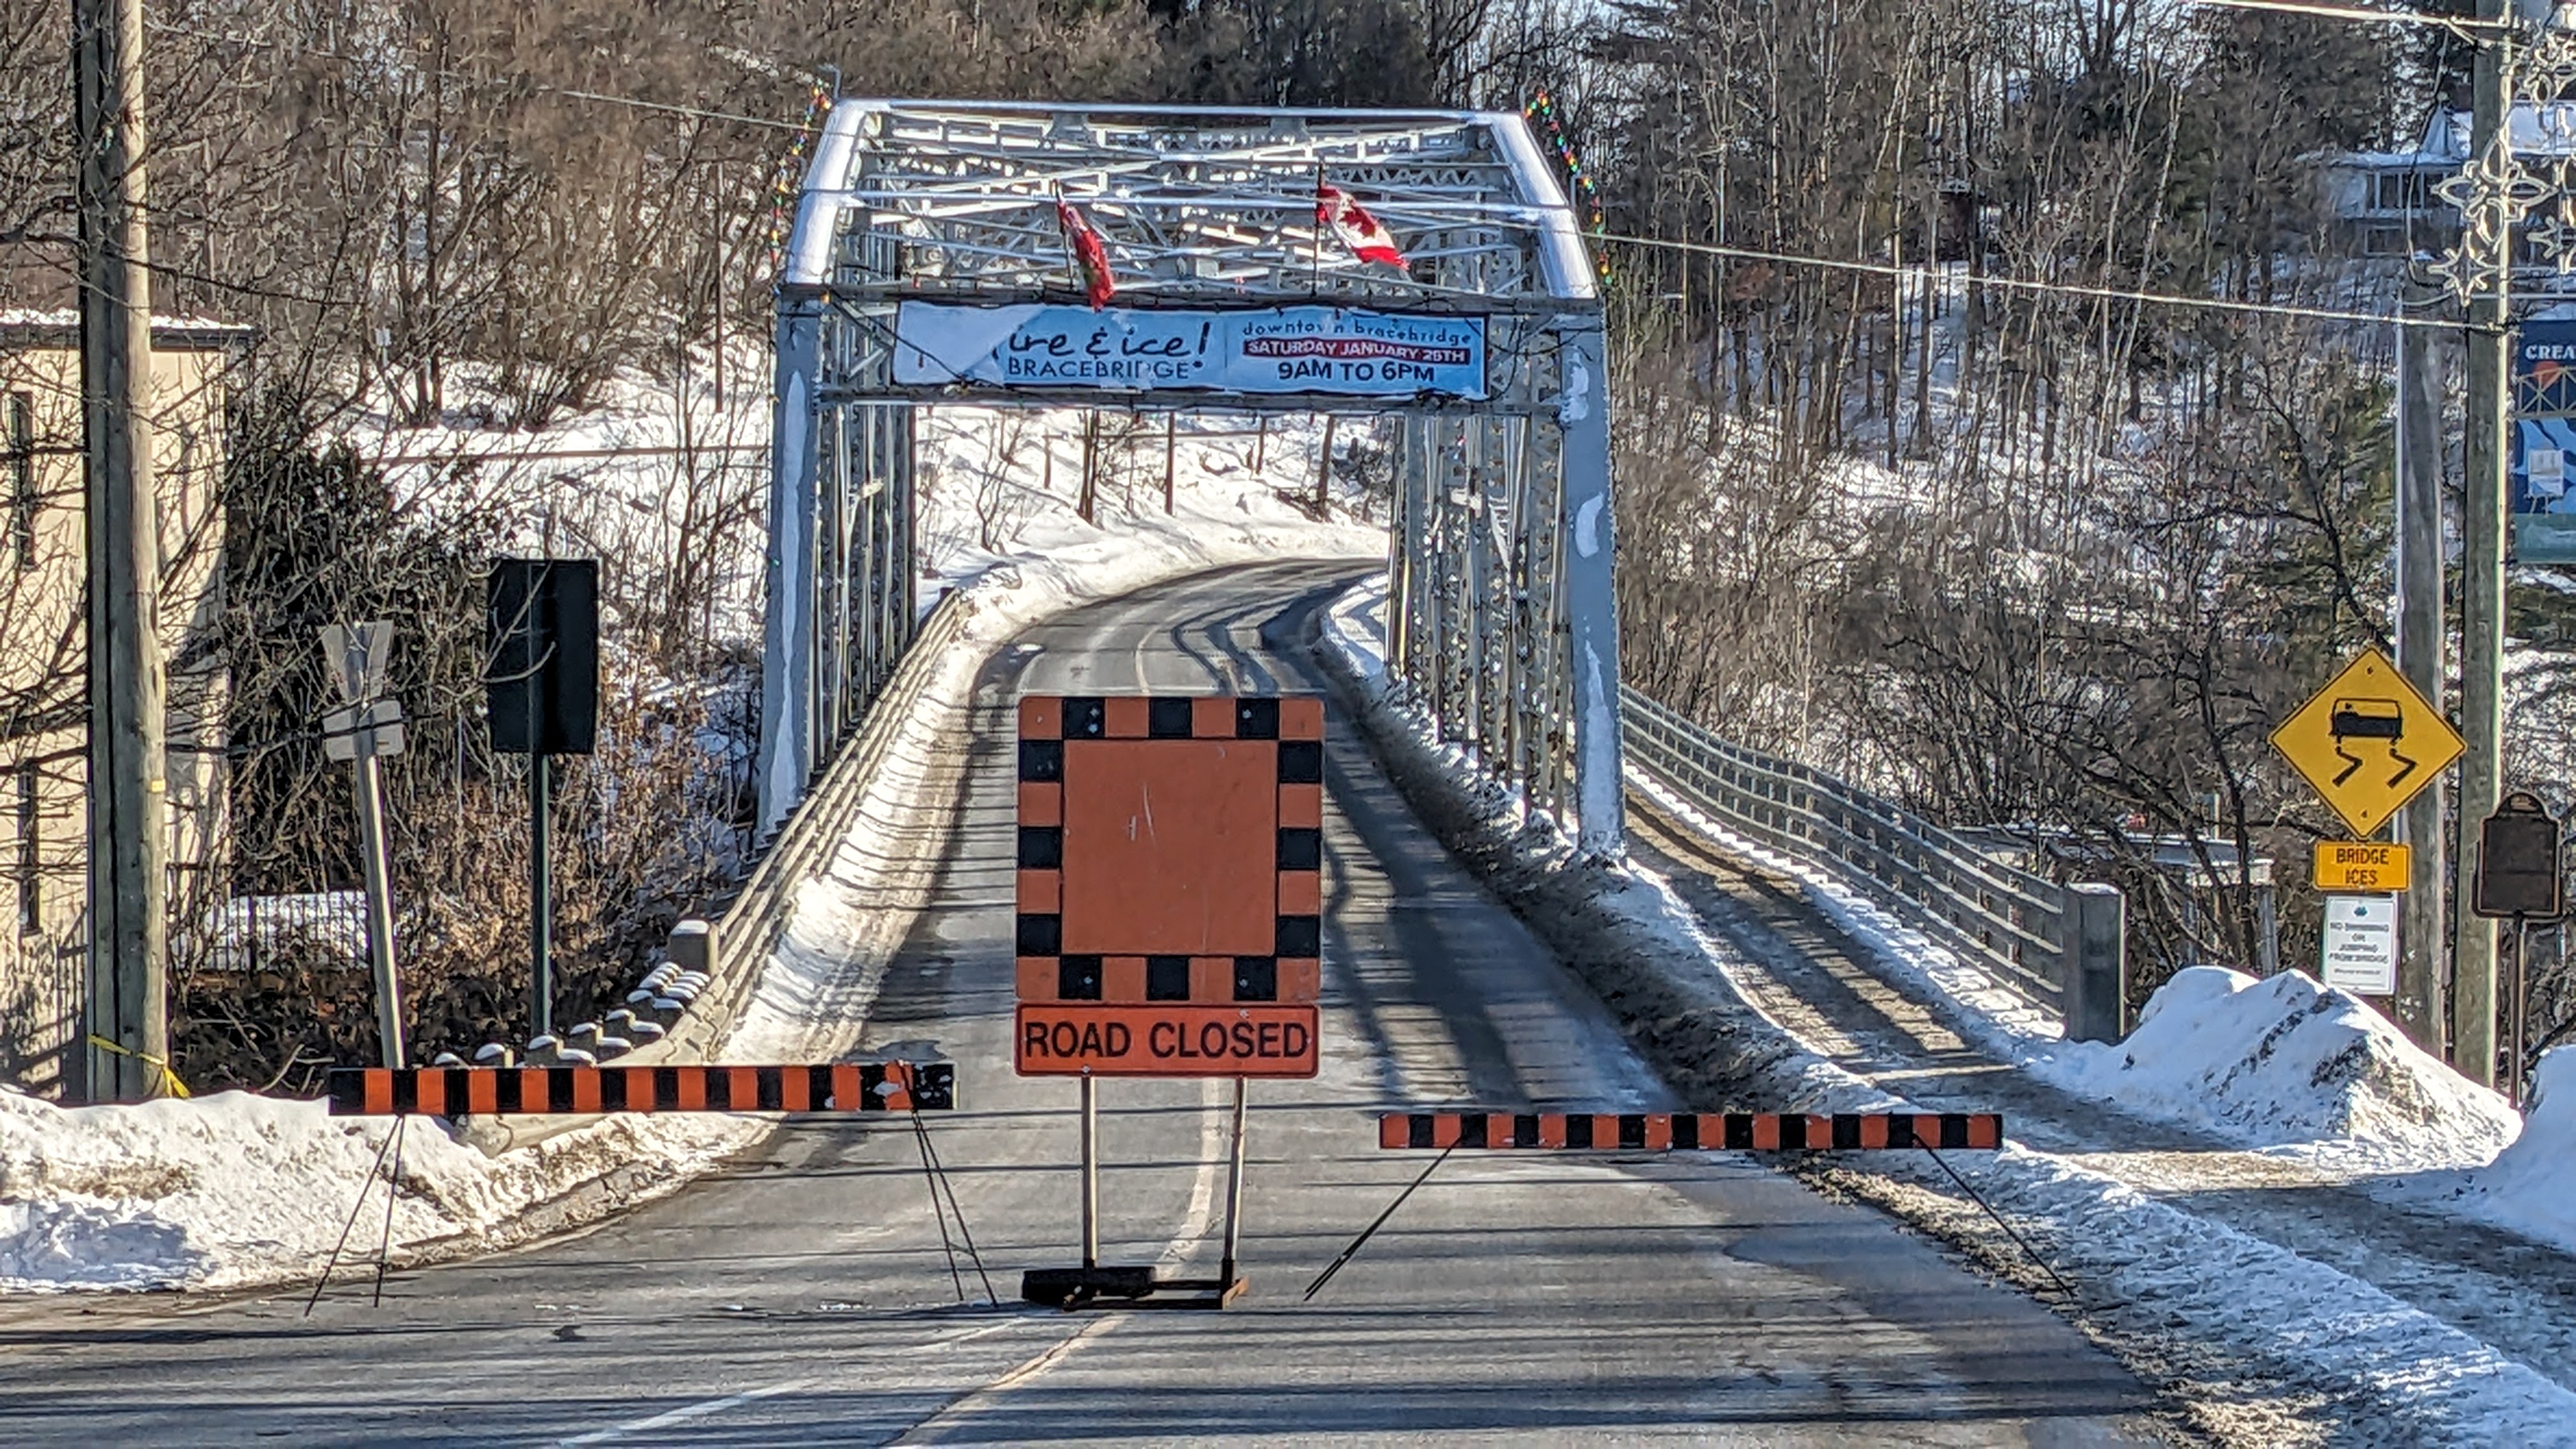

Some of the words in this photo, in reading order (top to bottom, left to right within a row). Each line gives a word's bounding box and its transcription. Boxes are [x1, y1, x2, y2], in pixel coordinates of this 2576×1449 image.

[992, 323, 1075, 360] ire
[1121, 321, 1211, 356] ice!
[1354, 319, 1471, 346] bracebridge
[1248, 340, 1337, 355] SATURDAY
[1340, 341, 1420, 360] JANUARY
[2525, 344, 2576, 360] CREA
[1278, 360, 1332, 380] 9AM
[1339, 362, 1373, 381] TO
[1382, 361, 1435, 382] 6PM
[2336, 848, 2389, 864] BRIDGE
[2345, 868, 2379, 885] ICES
[1025, 1022, 1131, 1059] ROAD
[1149, 1020, 1308, 1059] CLOSED
